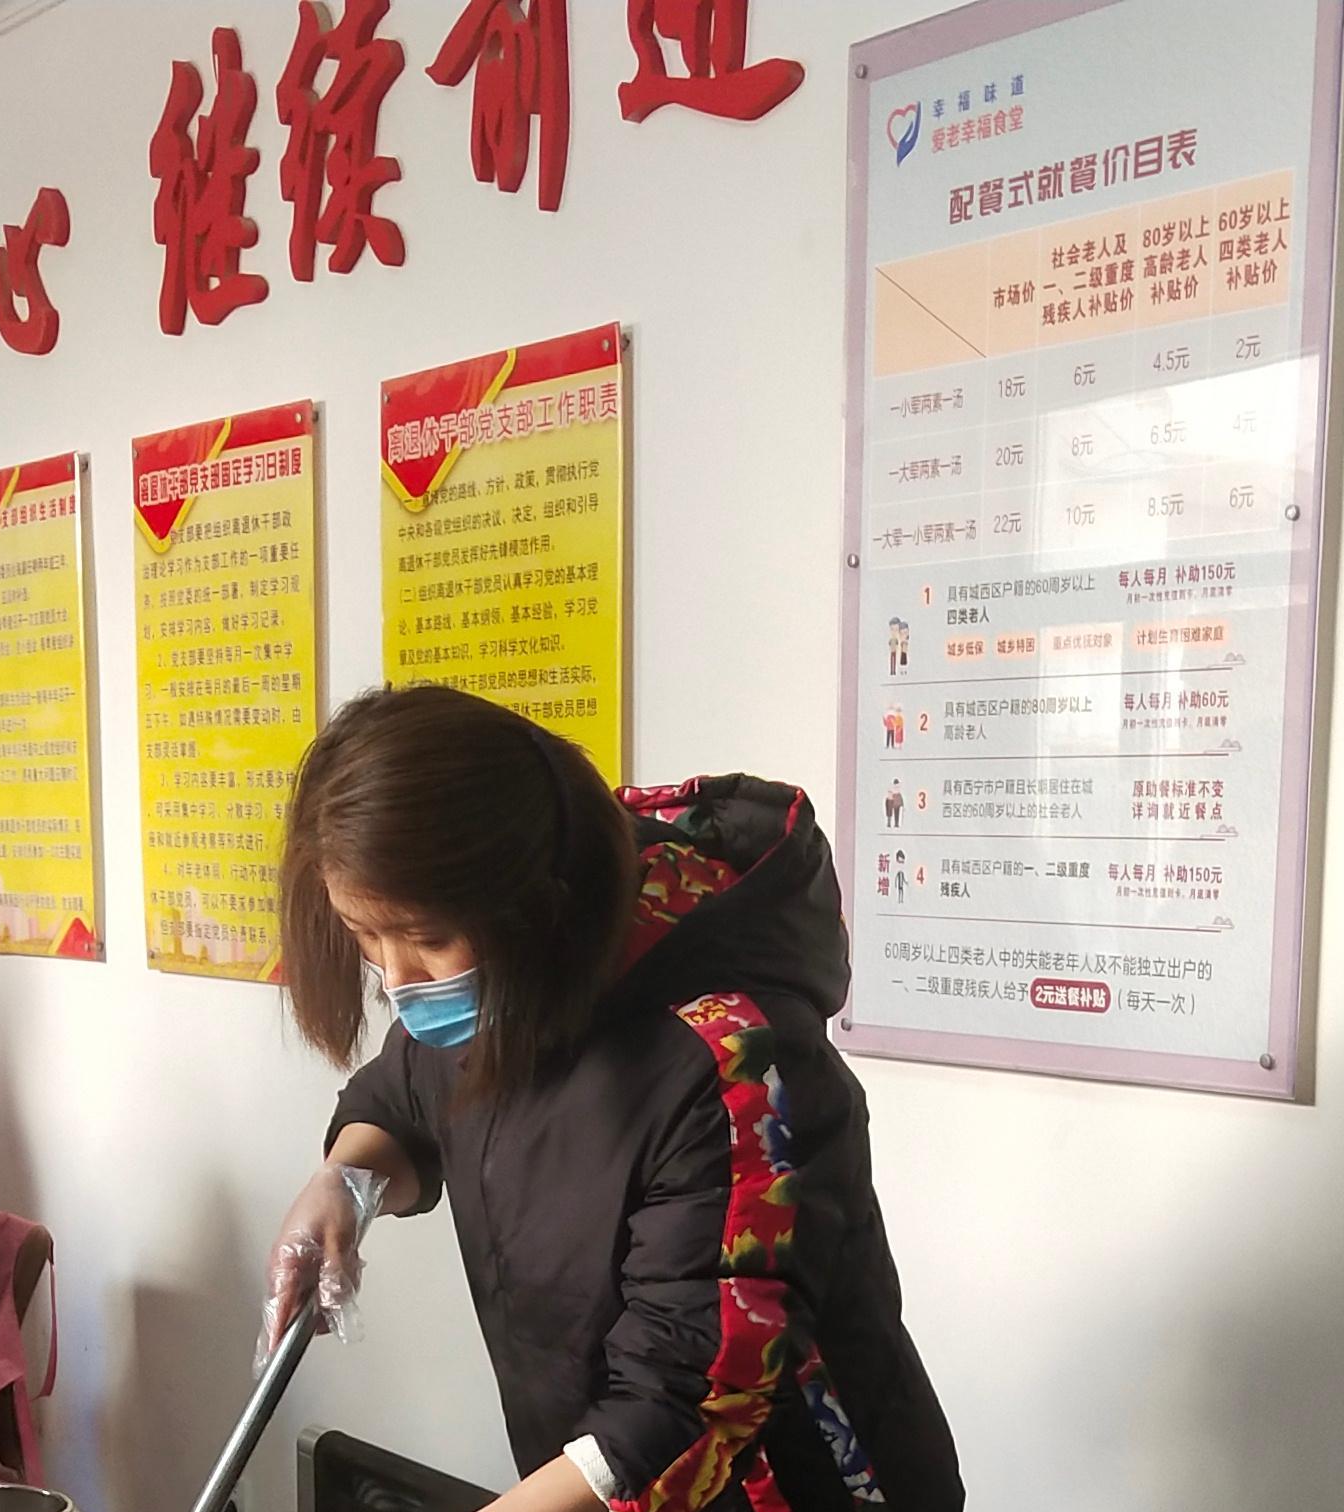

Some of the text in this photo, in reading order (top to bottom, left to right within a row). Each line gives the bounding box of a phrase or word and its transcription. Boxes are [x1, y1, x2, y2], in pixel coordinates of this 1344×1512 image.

[932, 74, 1025, 119] 幸福味道
[931, 105, 1025, 154] 爱老幸福食堂
[949, 128, 1198, 225] 配餐式就餐价目表
[1218, 197, 1290, 232] 60岁以上
[1142, 217, 1211, 249] 80岁以上
[1218, 229, 1288, 263] 四类老人
[1051, 233, 1128, 269] 社会老人及
[1142, 246, 1209, 279] 高龄老人
[1042, 261, 1135, 293] 一、二级重度
[1226, 260, 1278, 291] 补贴价
[993, 280, 1036, 309] 市场价
[1042, 290, 1135, 326] 残疾人补贴价
[1150, 279, 1198, 306] 补贴价
[890, 336, 1261, 418] 一小荤两素一汤 18元 6元 4.5元 2元
[387, 382, 617, 464] 离退休干部党支部工作职责
[889, 455, 962, 483] 一大荤两素一汤
[995, 444, 1024, 466] 20元
[1071, 435, 1094, 456] 8元
[1150, 420, 1187, 445] 6.5元
[994, 512, 1022, 534] 22元
[1066, 504, 1095, 526] 10元
[1148, 493, 1184, 517] 8.5元
[1229, 485, 1254, 509] 6元
[1118, 562, 1236, 589] 每人每月 补助150元
[923, 587, 932, 605] 1
[946, 606, 990, 625] 四类老人
[1123, 689, 1229, 712] 每人每月 补助60元
[920, 714, 928, 731] 2
[943, 723, 987, 741] 高龄老人
[917, 792, 927, 809] 3
[1131, 779, 1224, 800] 原助餐标准不变
[1131, 801, 1223, 821] 详询就近餐点
[877, 853, 891, 896] 新增
[916, 867, 925, 884] 4
[1107, 862, 1223, 885] 每人每月 补助150元
[940, 881, 971, 899] 残疾人
